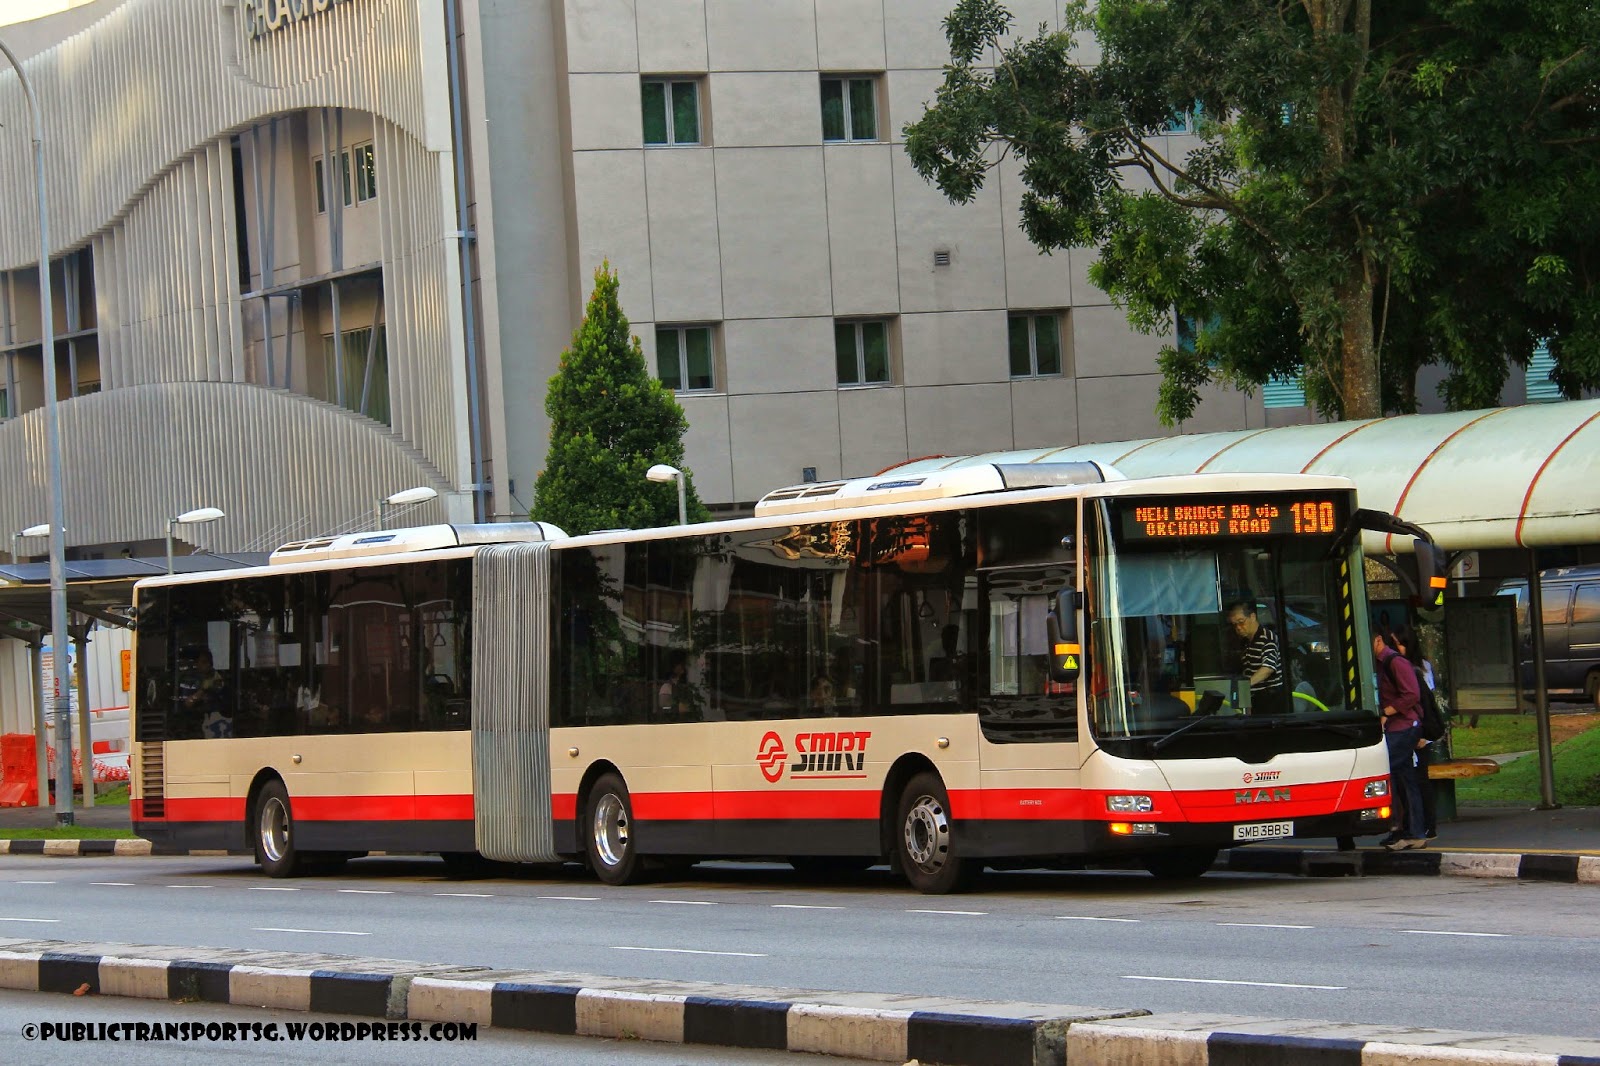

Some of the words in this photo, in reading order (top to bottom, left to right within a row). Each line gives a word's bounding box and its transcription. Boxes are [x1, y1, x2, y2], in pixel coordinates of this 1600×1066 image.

[1135, 508, 1169, 522] NEW
[1174, 506, 1226, 521] BRIDGE
[1231, 505, 1251, 519] RD
[1255, 504, 1279, 518] via
[1289, 502, 1335, 534] 190
[1146, 521, 1220, 536] ORCHARD
[1229, 519, 1271, 534] ROAD
[790, 731, 872, 772] SMRT
[1254, 771, 1282, 781] SMRT
[1235, 788, 1291, 803] MAN
